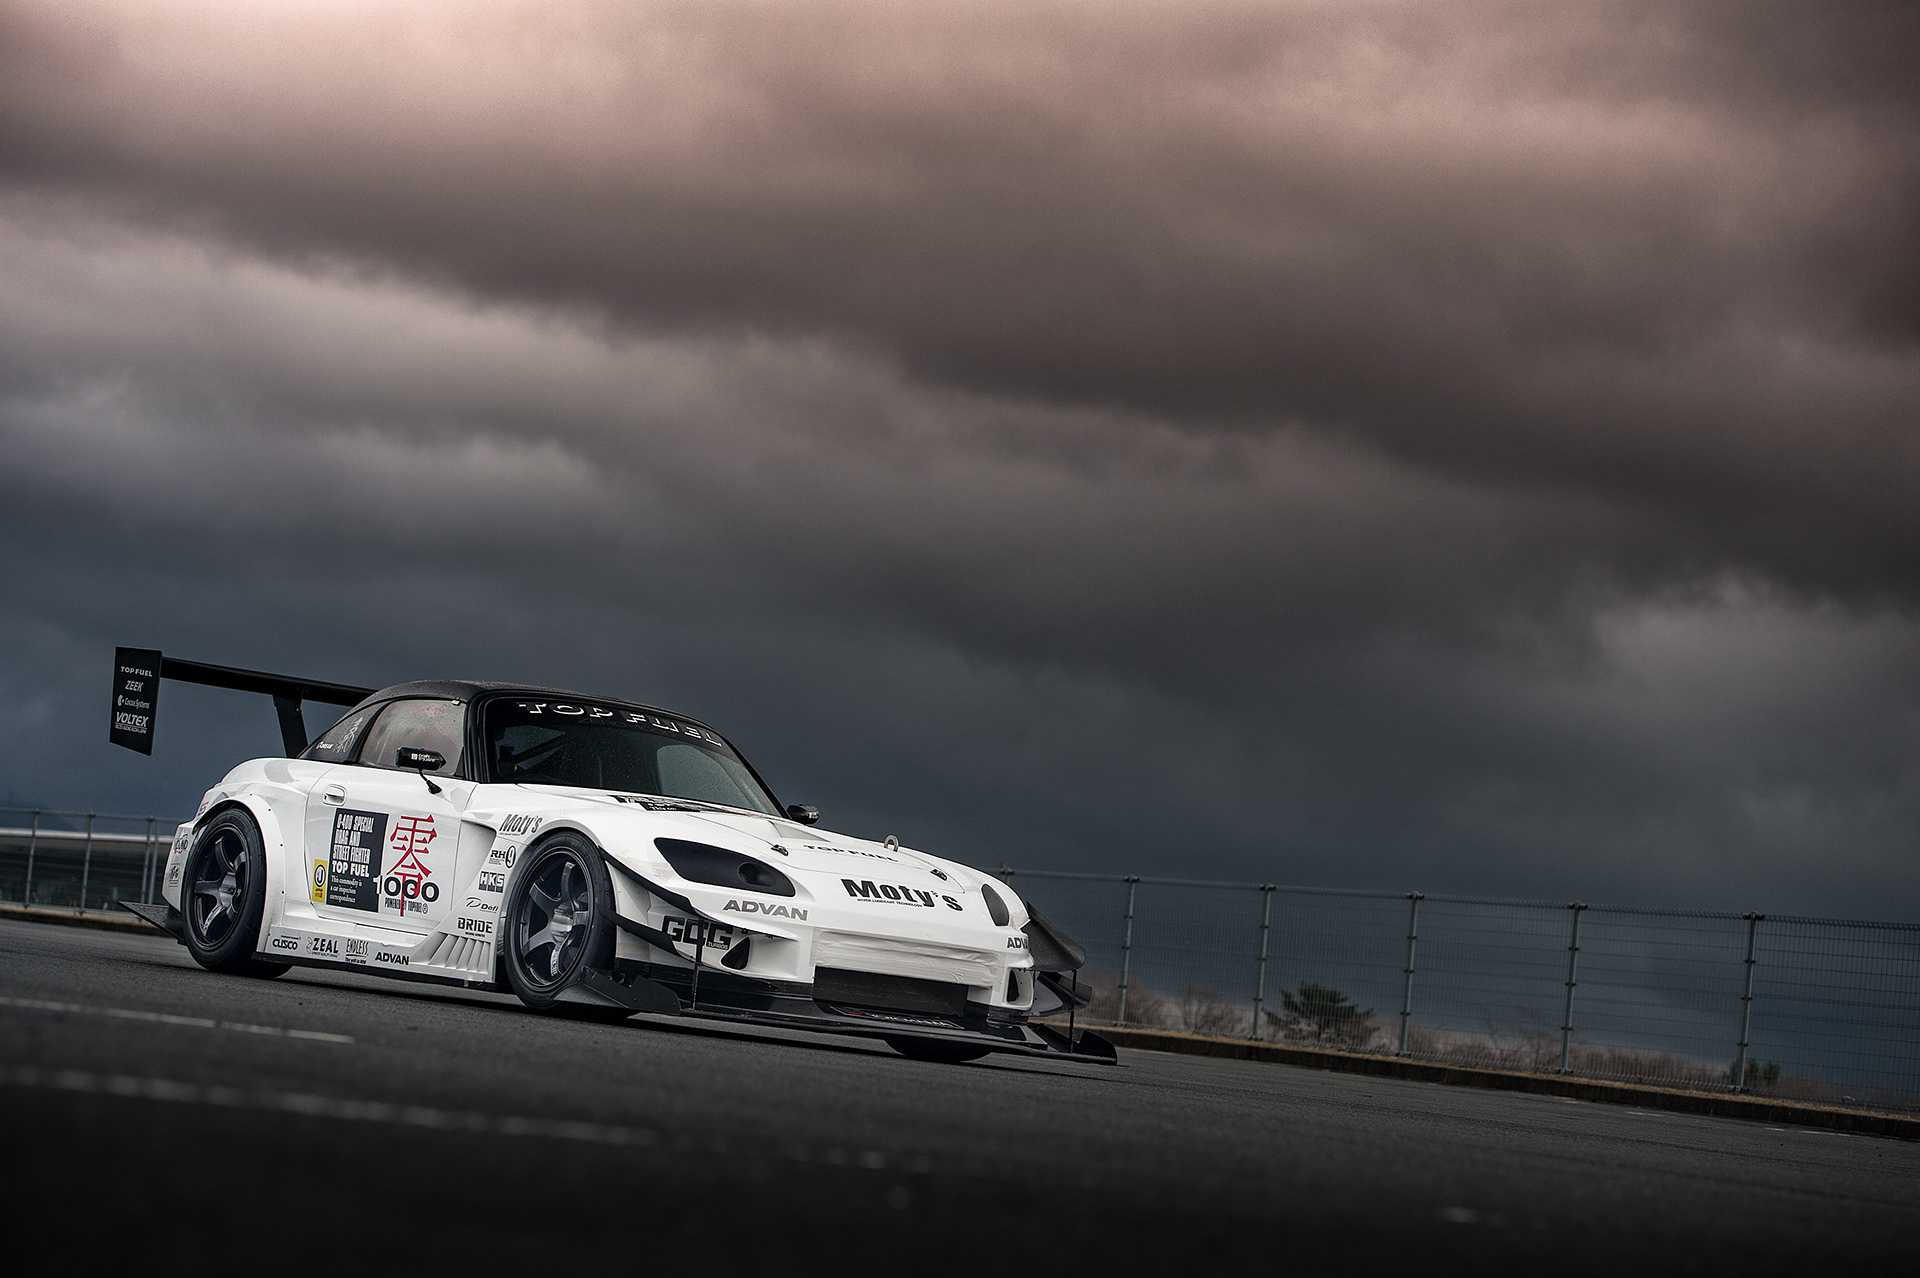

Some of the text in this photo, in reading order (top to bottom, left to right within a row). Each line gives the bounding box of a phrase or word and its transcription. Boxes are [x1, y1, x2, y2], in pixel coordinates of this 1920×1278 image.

[120, 665, 153, 677] TOP FUEL
[124, 680, 144, 692] ZEEK
[116, 711, 149, 727] VOLTEX
[517, 701, 722, 747] TOP FUEL
[353, 815, 375, 833] SPECIAL
[499, 813, 543, 835] Moty's
[348, 830, 361, 846] AND
[332, 844, 371, 864] STREET FIGHTER
[803, 844, 899, 862] TOP FUEL
[332, 860, 370, 878] TOP FUEL
[479, 871, 505, 893] HKS
[840, 878, 963, 912] Moty's
[723, 900, 809, 921] ADVAN
[457, 917, 493, 934] BRIDE
[272, 938, 298, 951] CUSCO
[312, 938, 340, 953] ZEAL
[346, 938, 369, 956] ENDLESS
[375, 952, 410, 965] ADVAN
